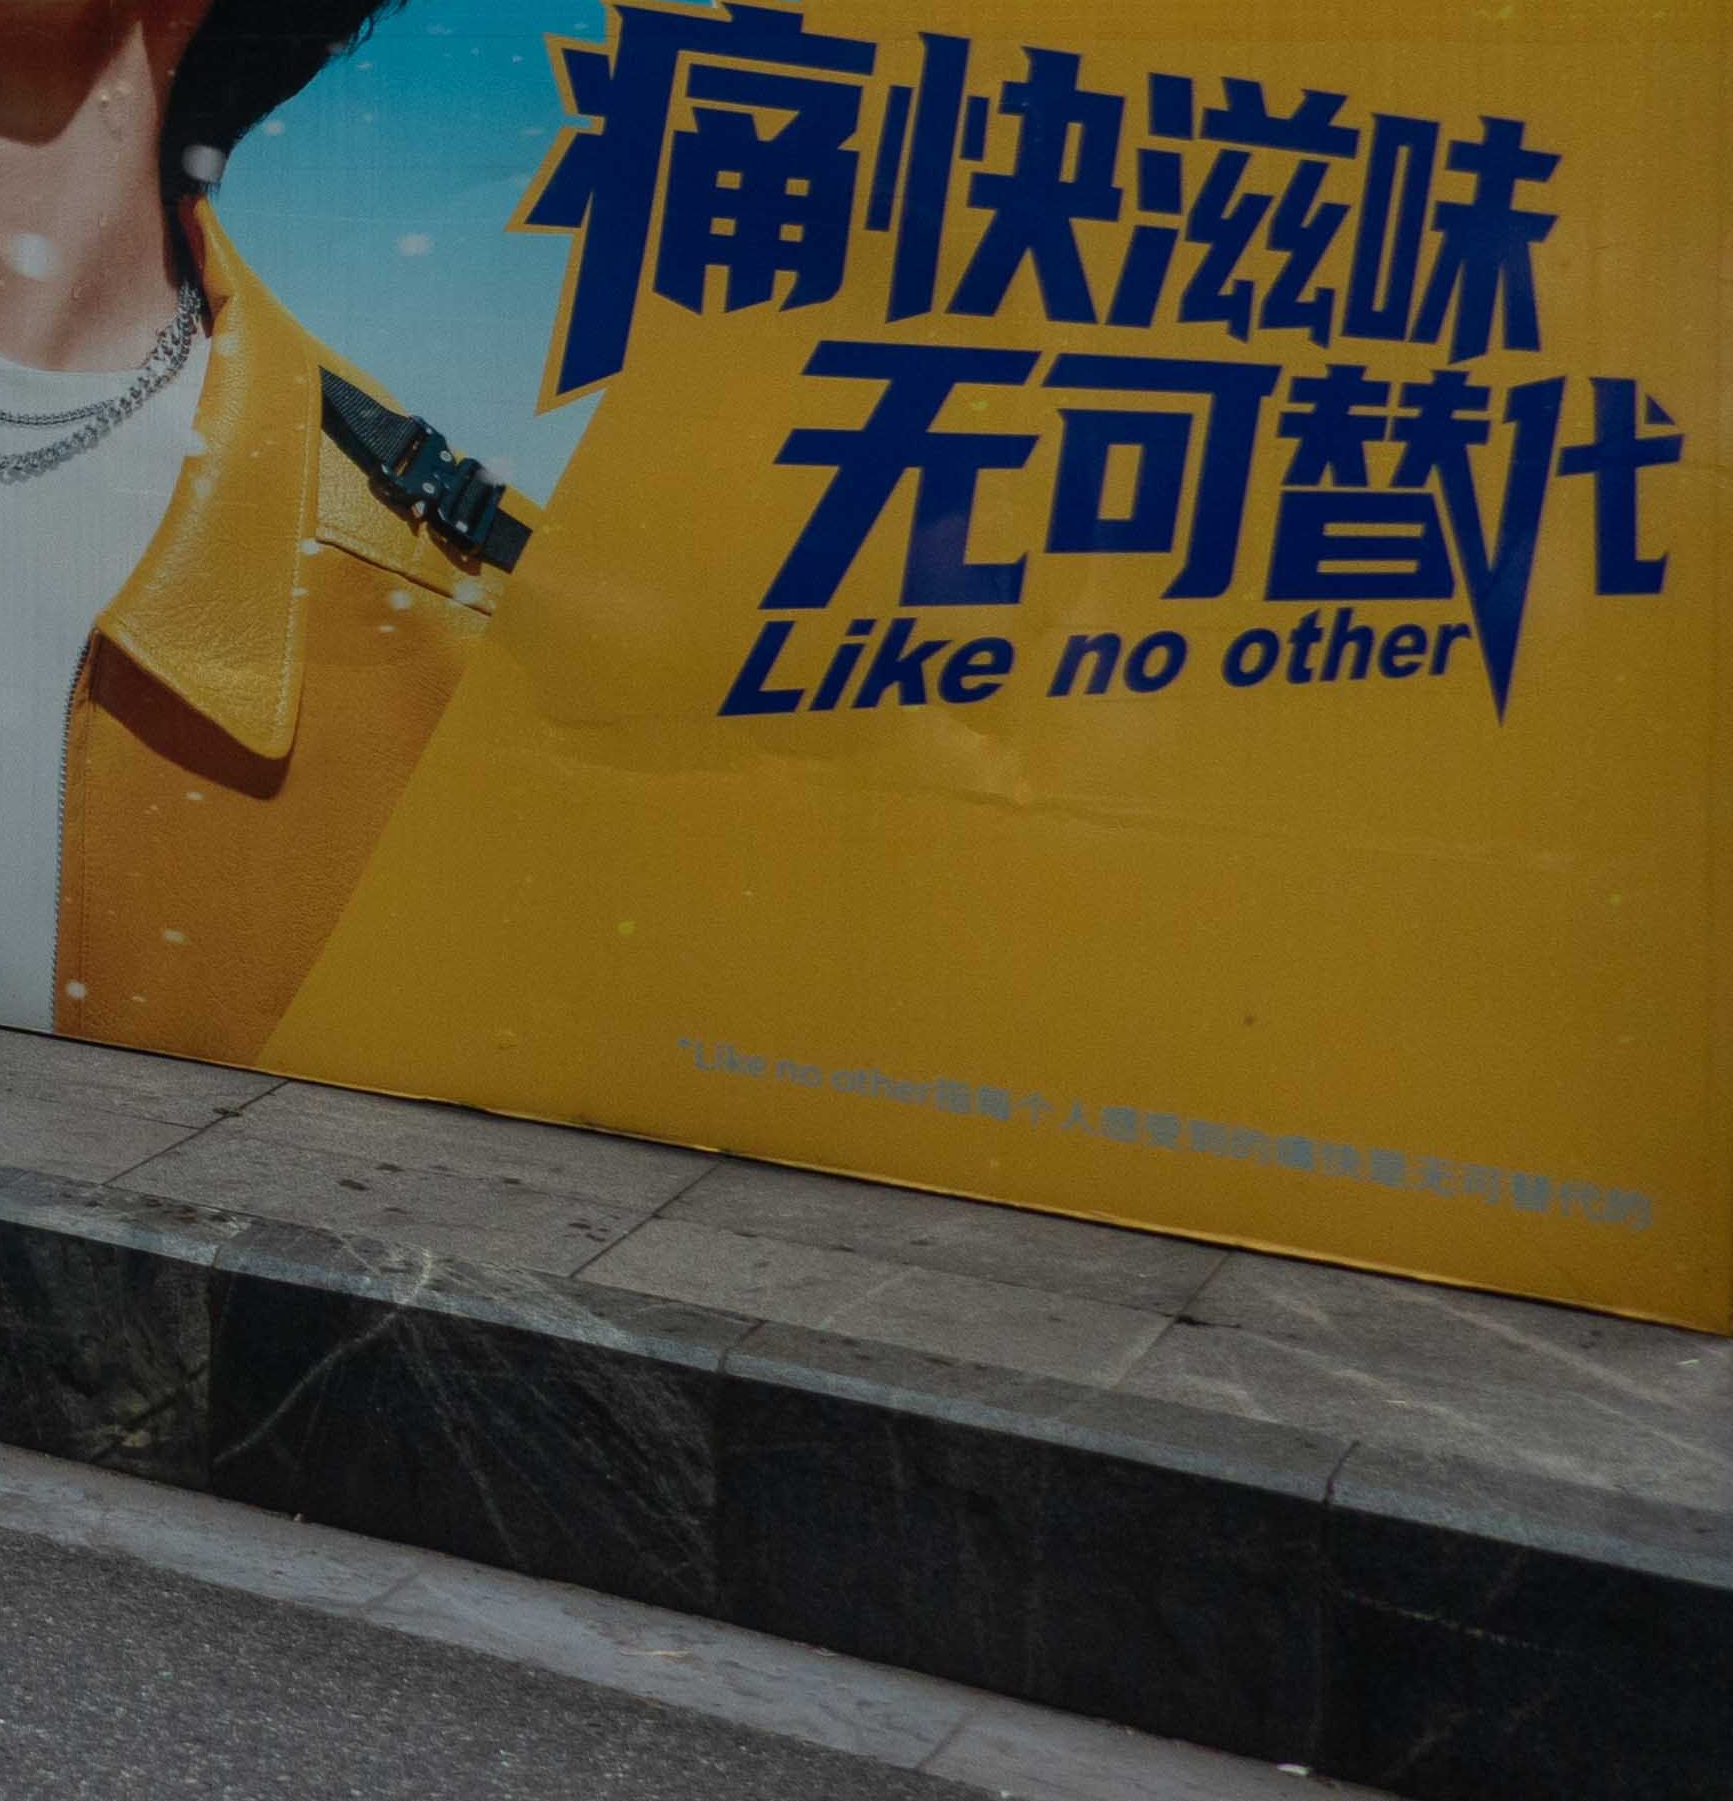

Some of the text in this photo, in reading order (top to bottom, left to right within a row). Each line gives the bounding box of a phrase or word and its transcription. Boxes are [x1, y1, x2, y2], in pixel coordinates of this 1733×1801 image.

[523, 2, 1563, 398] 痛快滋味
[757, 338, 1685, 728] 无可替代
[717, 607, 1471, 717] Like no other
[775, 1056, 823, 1088] no
